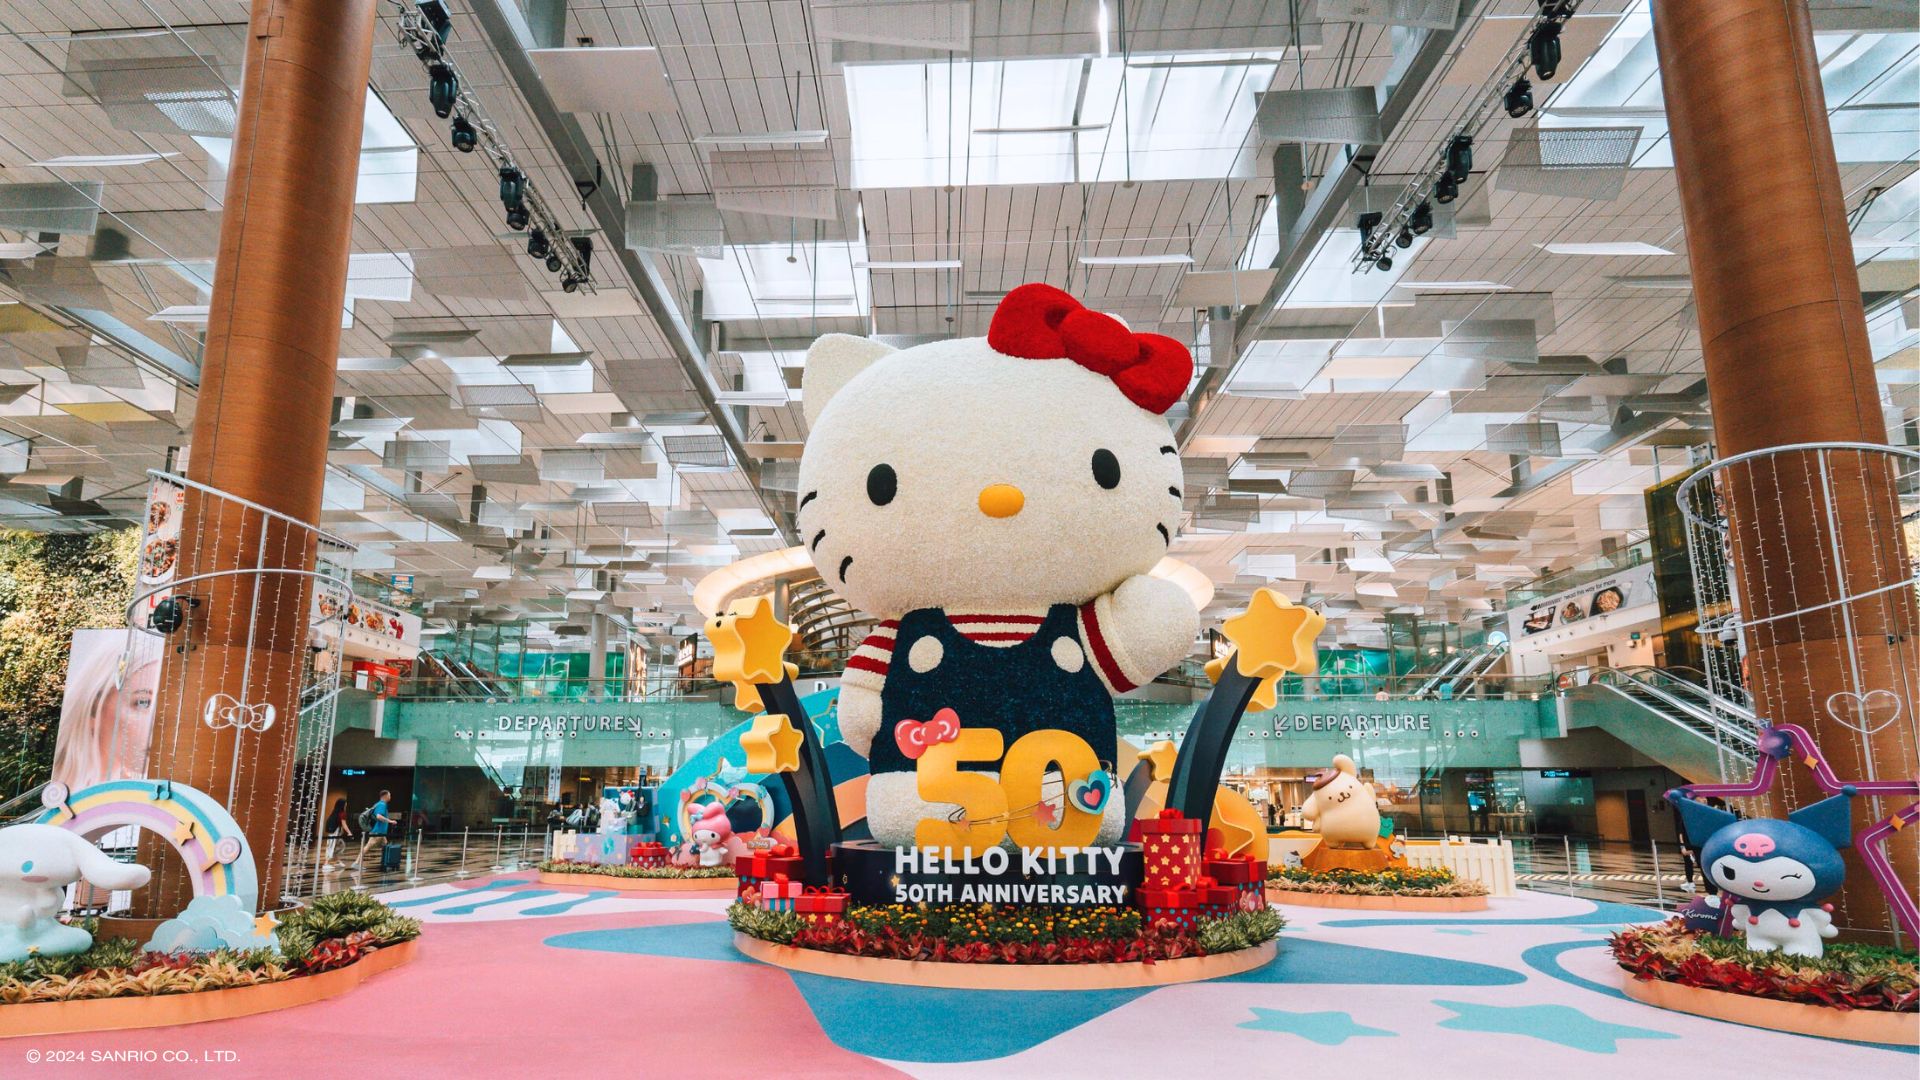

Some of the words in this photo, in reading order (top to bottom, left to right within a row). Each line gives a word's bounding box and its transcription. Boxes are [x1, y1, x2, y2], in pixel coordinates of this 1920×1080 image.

[498, 715, 625, 732] DEPARTURE
[1294, 714, 1431, 731] DEPARTURE
[915, 728, 1104, 860] 50
[895, 846, 1010, 875] HELLO
[1022, 846, 1125, 875] KITTY
[895, 884, 953, 902] 50TH
[960, 884, 1127, 904] ANNIVERSARY
[1681, 908, 1719, 920] Kuromi
